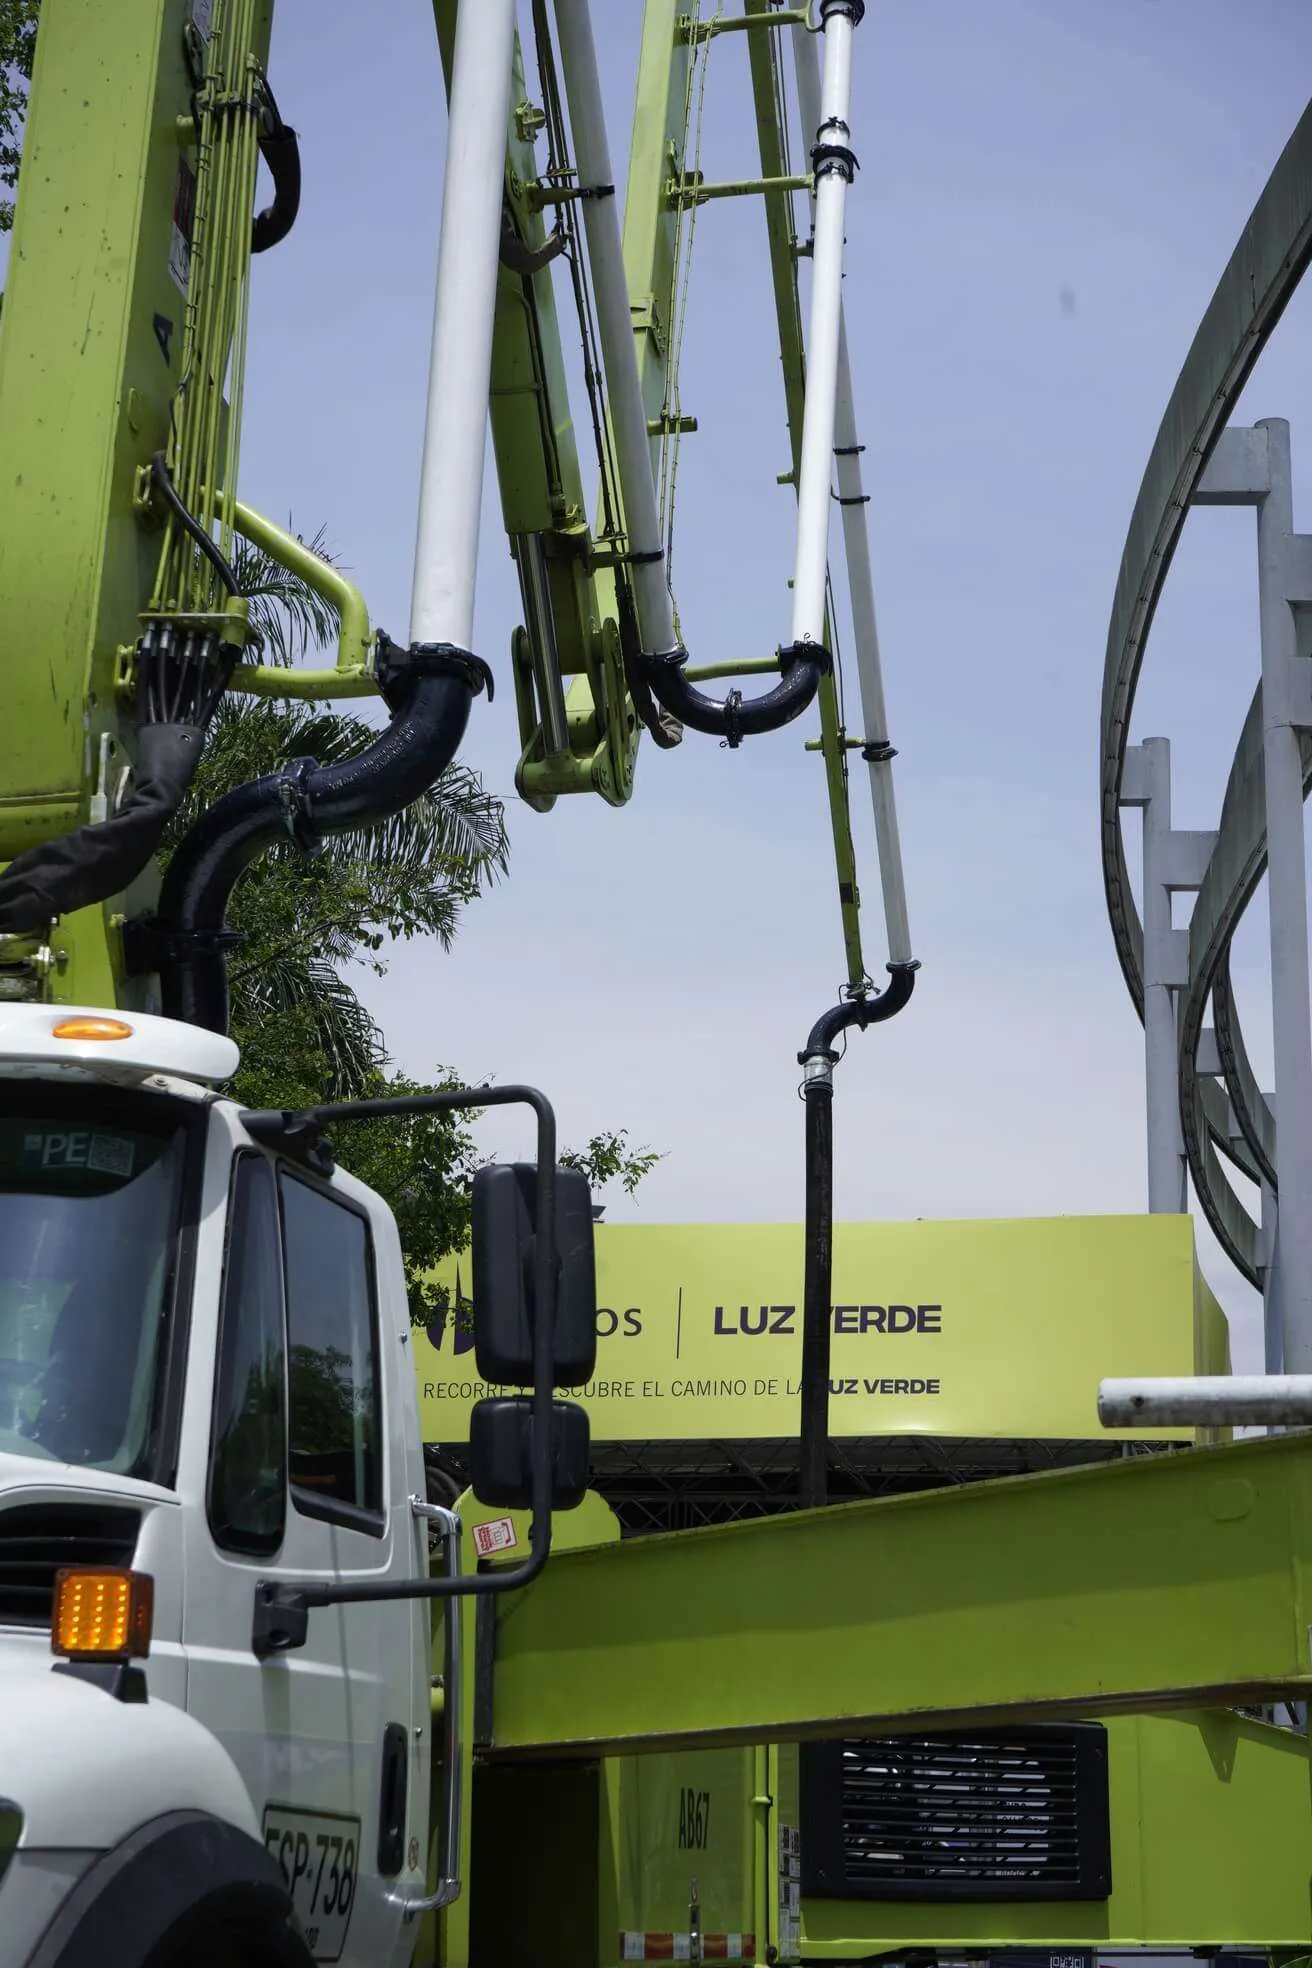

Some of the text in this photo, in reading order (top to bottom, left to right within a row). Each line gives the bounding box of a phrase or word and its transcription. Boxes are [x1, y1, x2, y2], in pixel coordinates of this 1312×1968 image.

[714, 1305, 942, 1335] LUZ ERDE
[553, 1381, 635, 1398] SCUBRE
[643, 1382, 664, 1397] EL
[671, 1380, 747, 1396] CAMINO
[754, 1379, 778, 1395] DE
[827, 1379, 858, 1394] UZ
[863, 1379, 940, 1394] VERDE
[678, 1787, 710, 1850] AB67
